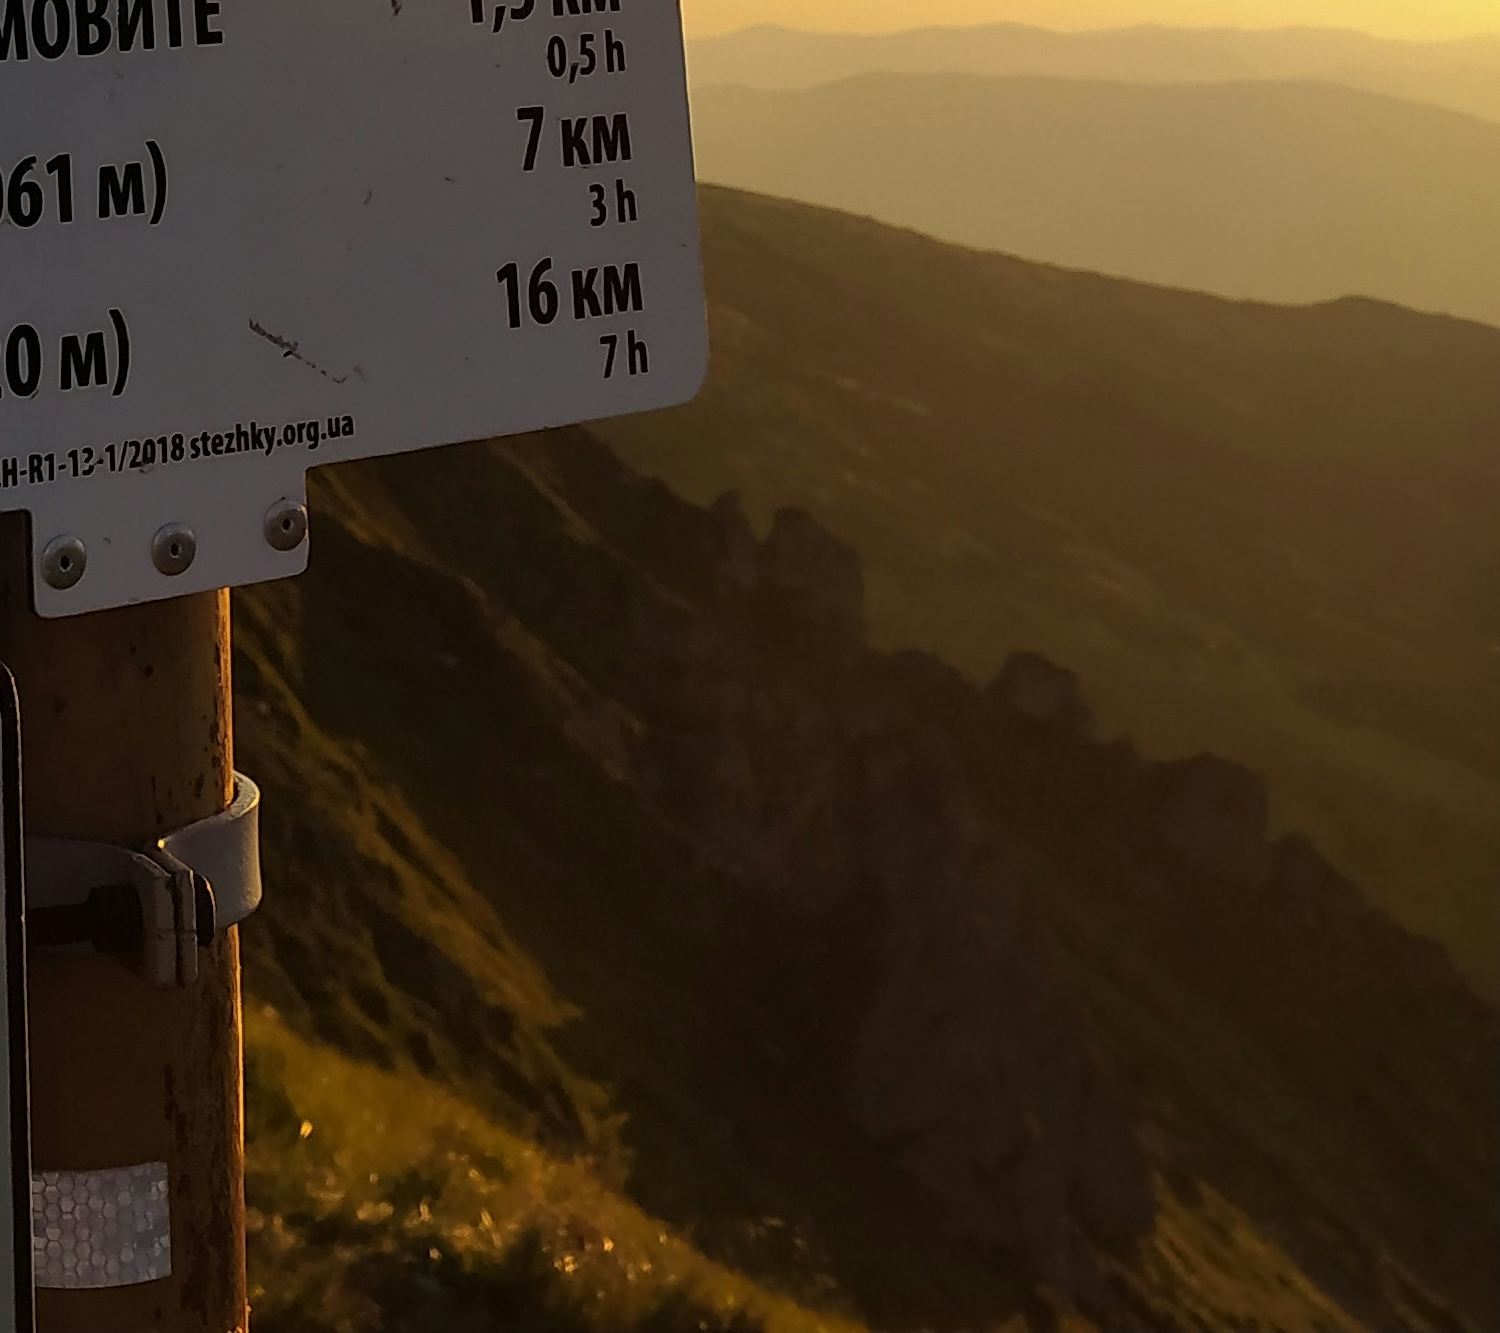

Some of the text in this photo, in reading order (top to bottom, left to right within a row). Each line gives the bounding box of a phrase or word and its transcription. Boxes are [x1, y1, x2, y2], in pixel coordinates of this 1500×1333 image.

[546, 29, 626, 84] 0,5 h
[516, 106, 632, 171] 7 км
[98, 140, 167, 225] м)
[589, 178, 638, 227] 3 h
[496, 257, 643, 329] 16 км
[60, 308, 130, 396] м)
[599, 329, 649, 379] 7 h
[189, 415, 354, 459] stezhky.org.ua
